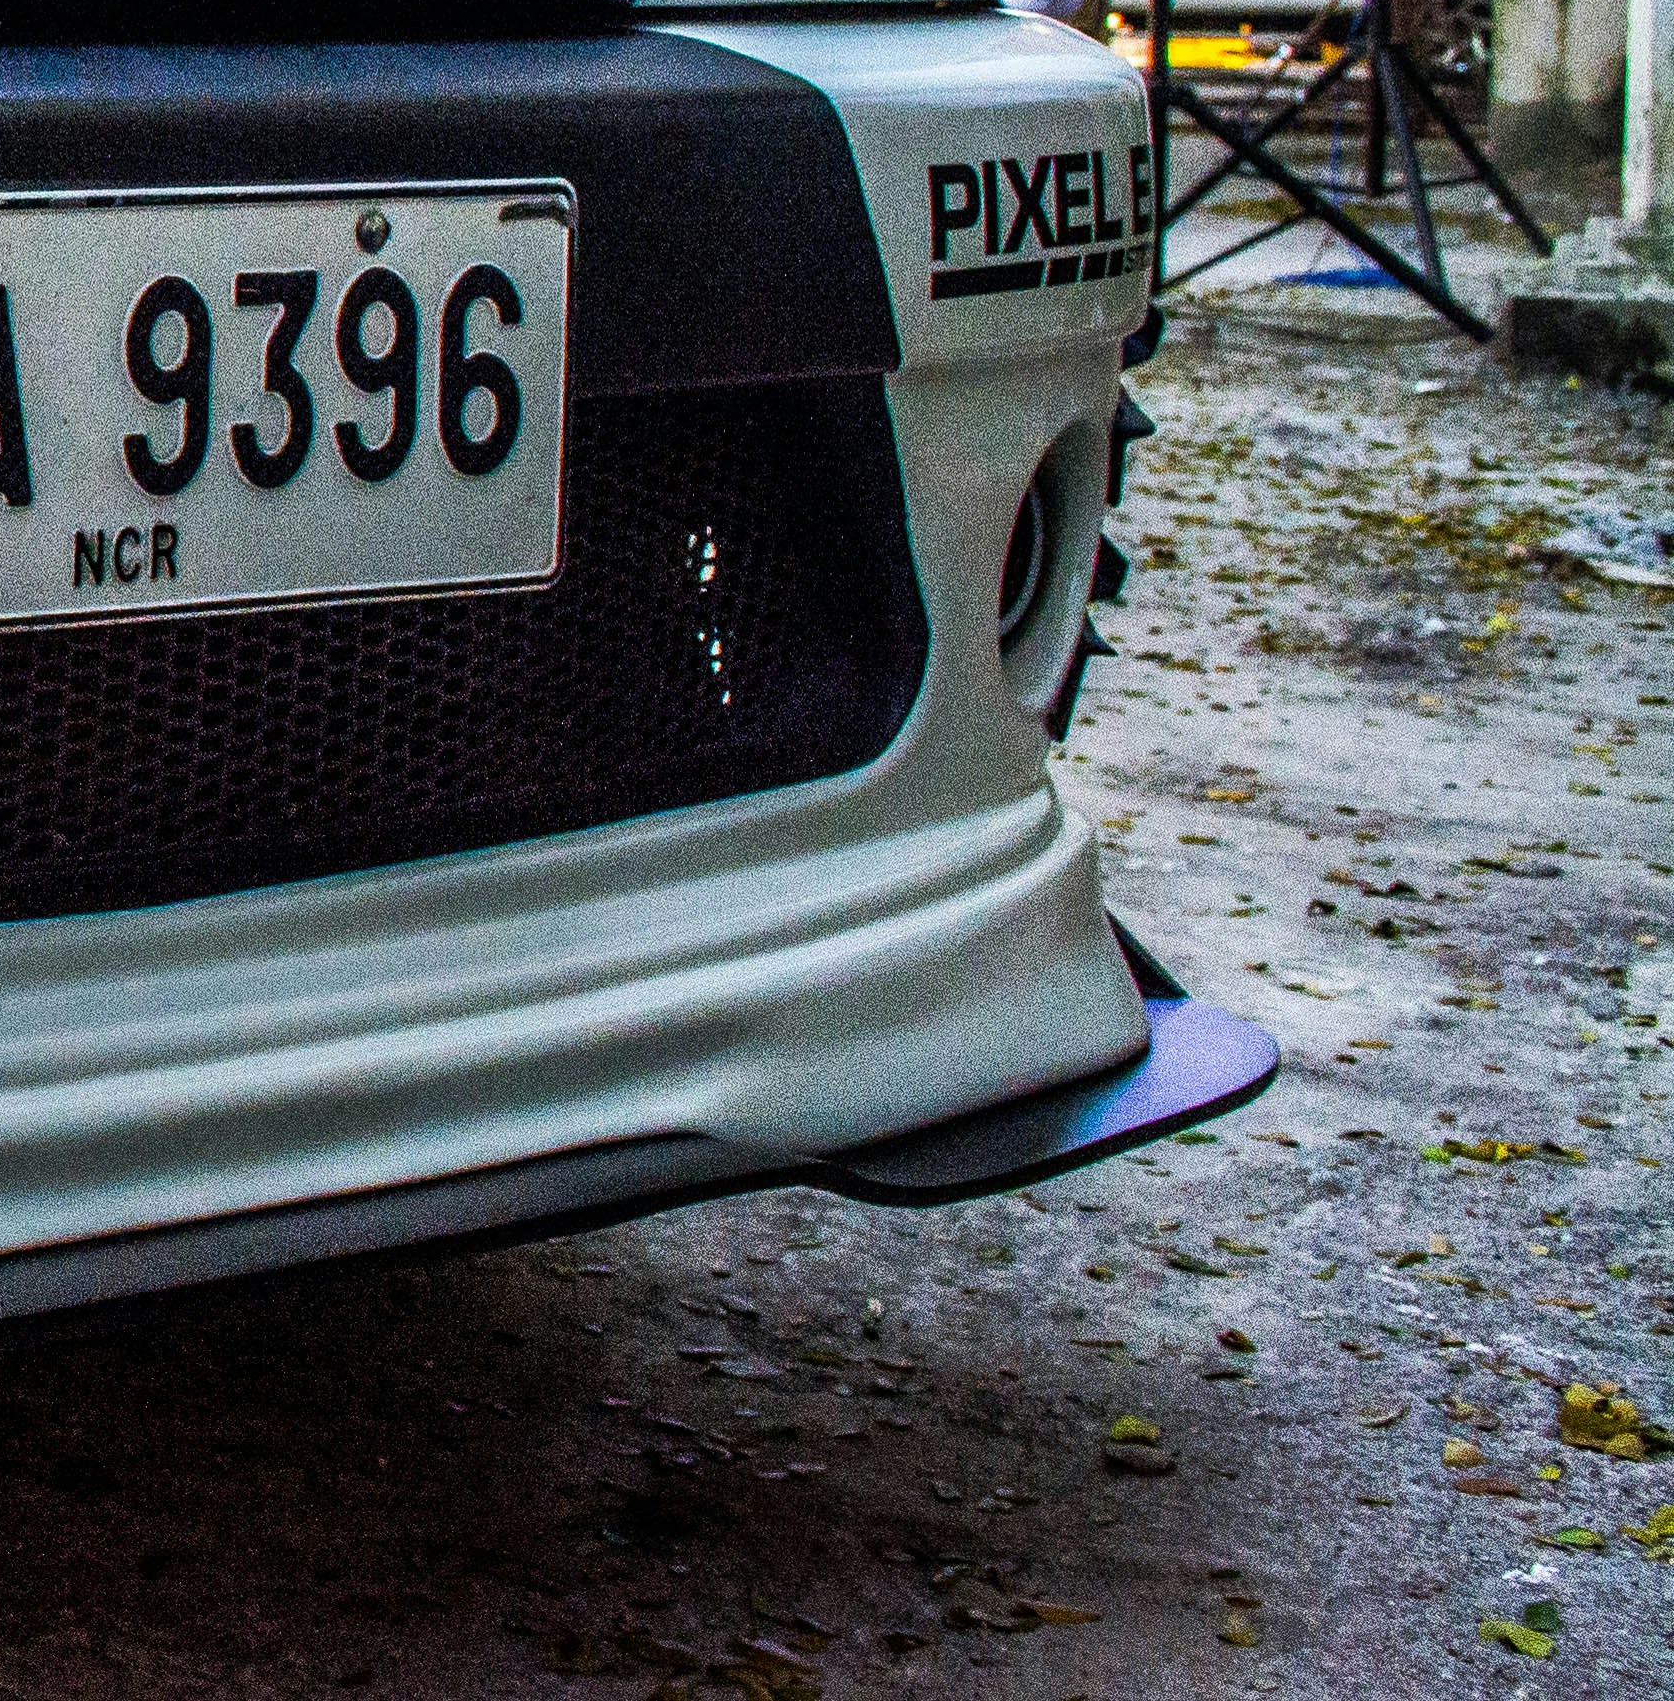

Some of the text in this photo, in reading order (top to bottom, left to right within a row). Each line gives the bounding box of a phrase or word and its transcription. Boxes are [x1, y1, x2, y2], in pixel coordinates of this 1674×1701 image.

[927, 149, 1125, 262] PIXEL
[122, 263, 526, 502] 9396
[72, 521, 181, 589] NCR
